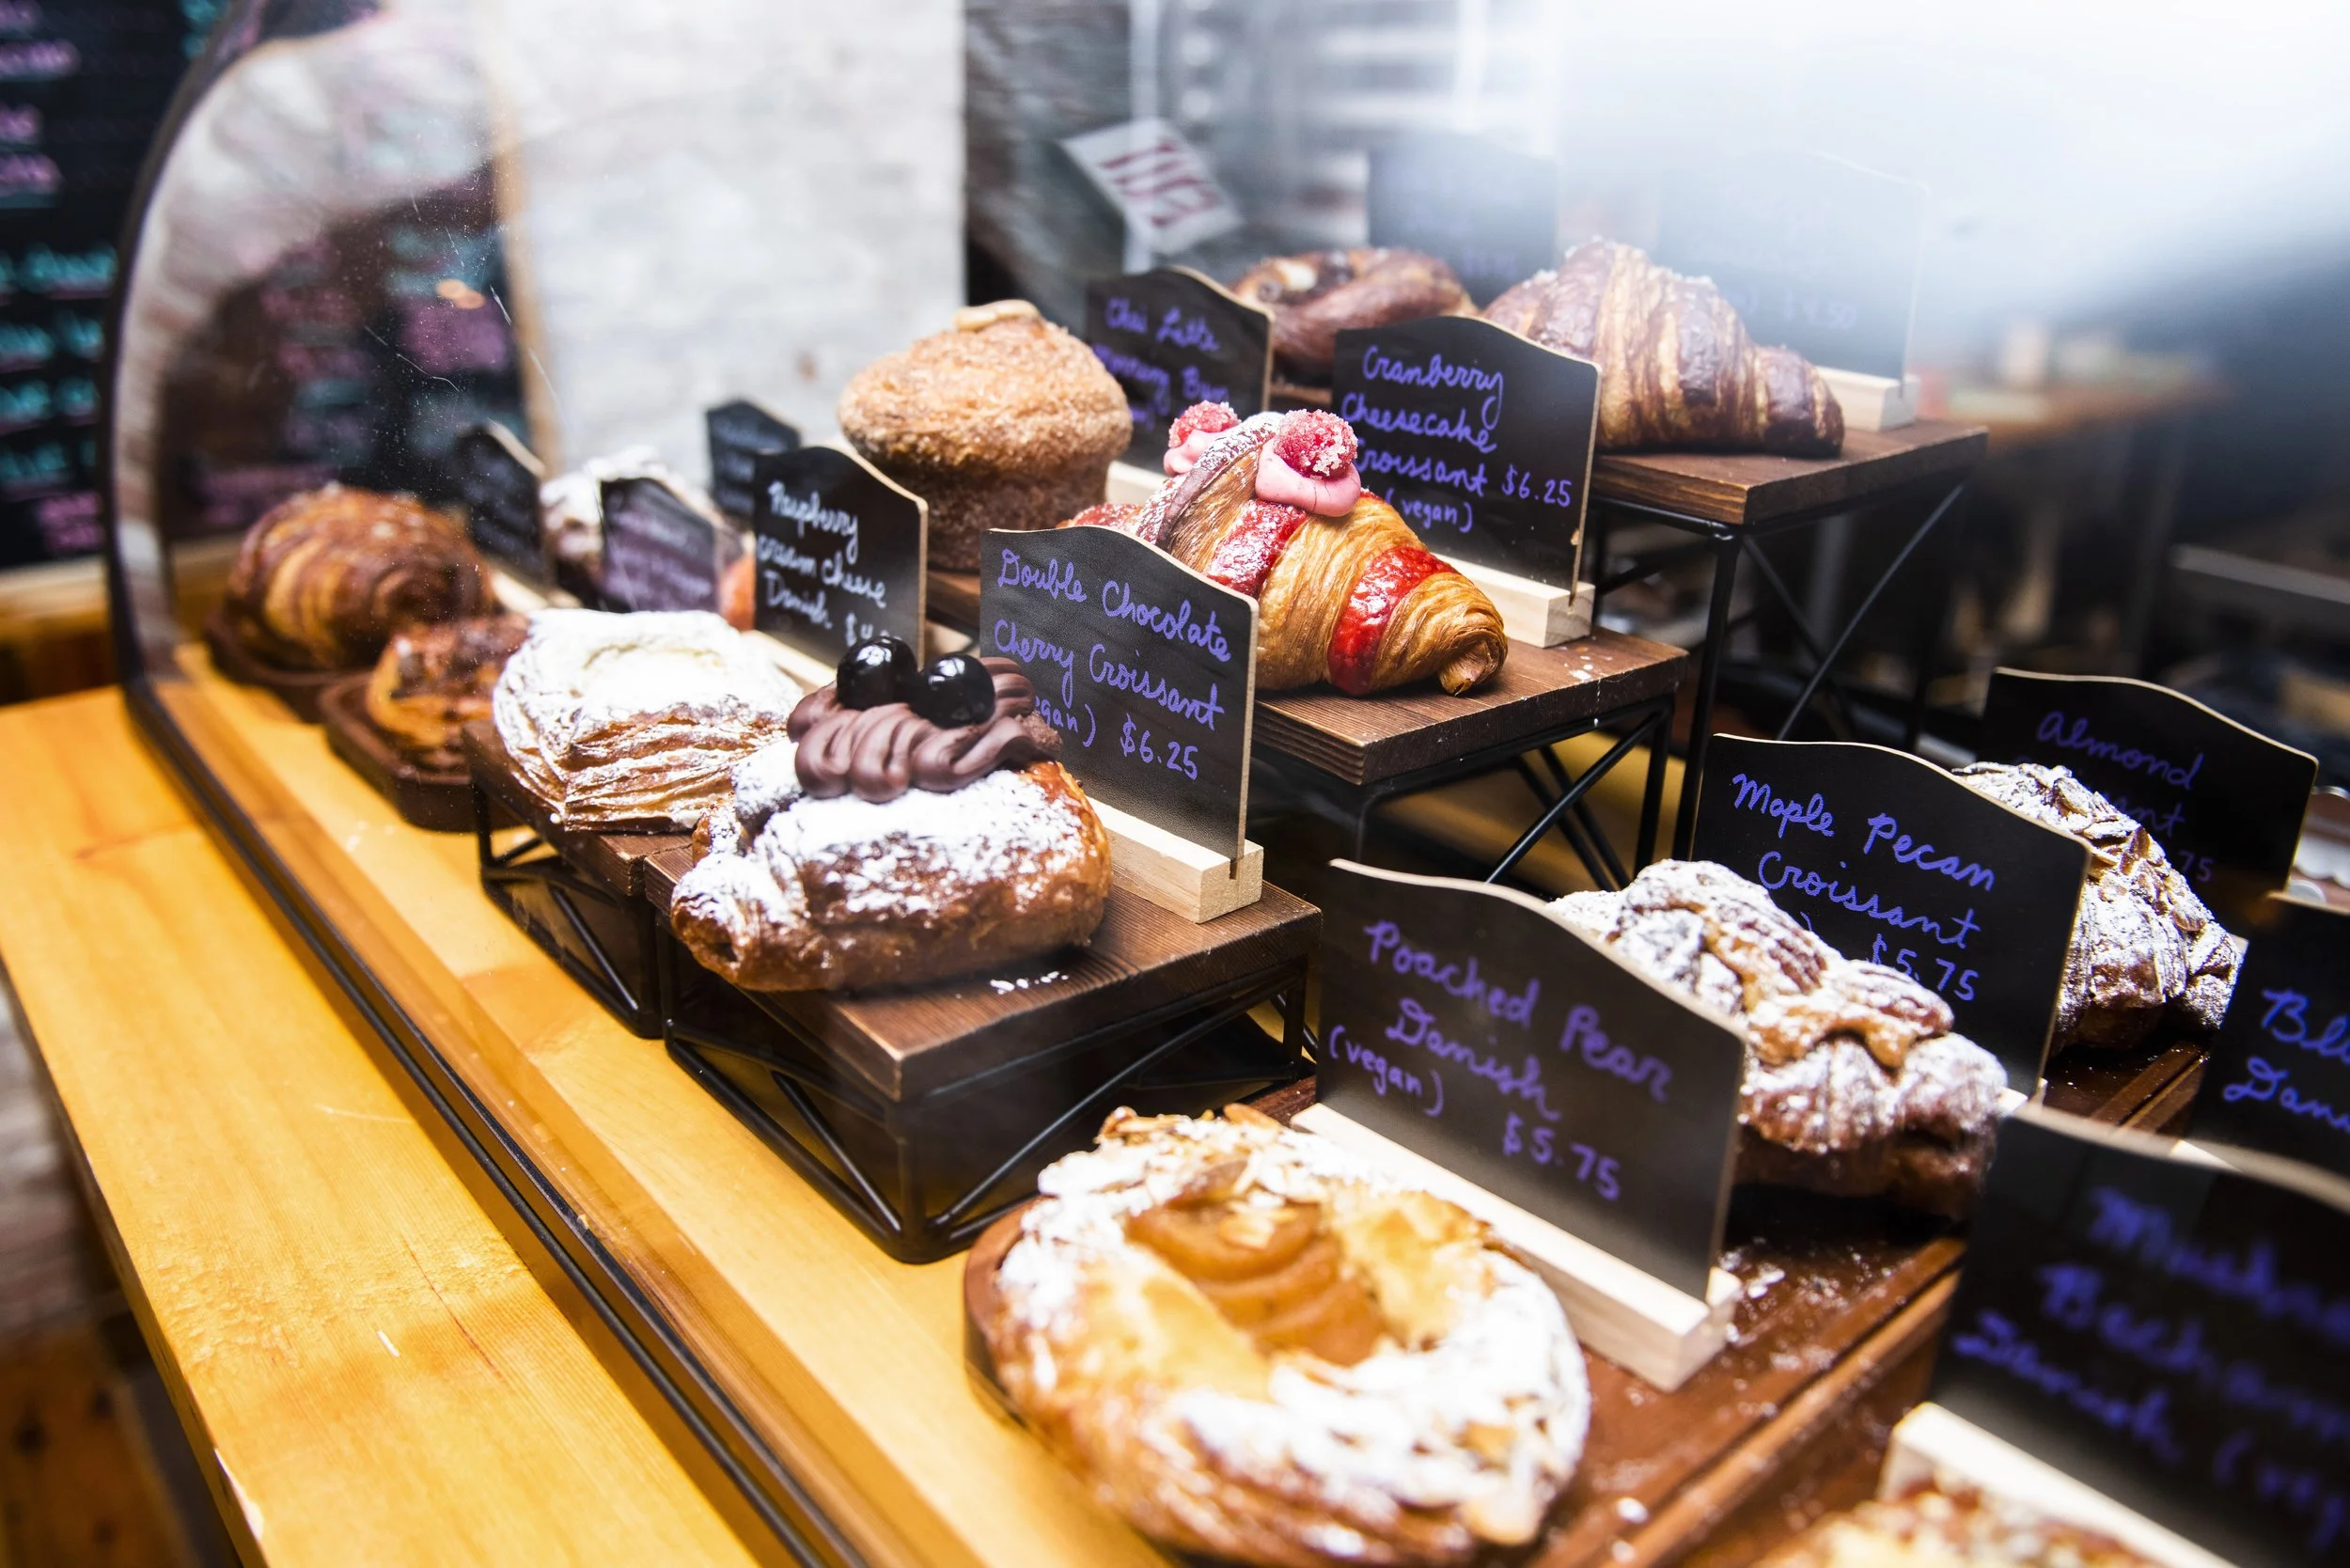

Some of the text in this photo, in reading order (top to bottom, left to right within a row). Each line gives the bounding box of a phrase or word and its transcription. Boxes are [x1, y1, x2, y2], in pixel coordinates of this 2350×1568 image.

[1341, 392, 1497, 453] Cheesecake
[1363, 345, 1504, 430] Cranberry
[1501, 463, 1573, 507] $6.25
[998, 548, 1231, 662] Double Chocolate
[994, 619, 1073, 709] Cherry
[1089, 643, 1225, 731] Croissant
[1036, 697, 1198, 781] gan) $6.25
[2036, 711, 2204, 791] Almond
[1732, 773, 1995, 892] Maple Pecan
[1758, 851, 1982, 949] Croissant
[1363, 919, 1673, 1103] Poached Pear
[1865, 933, 1981, 1001] $5.75
[1328, 1025, 1445, 1117] (vegan)
[1386, 998, 1562, 1121] Danish
[1503, 1112, 1622, 1200] $5.75
